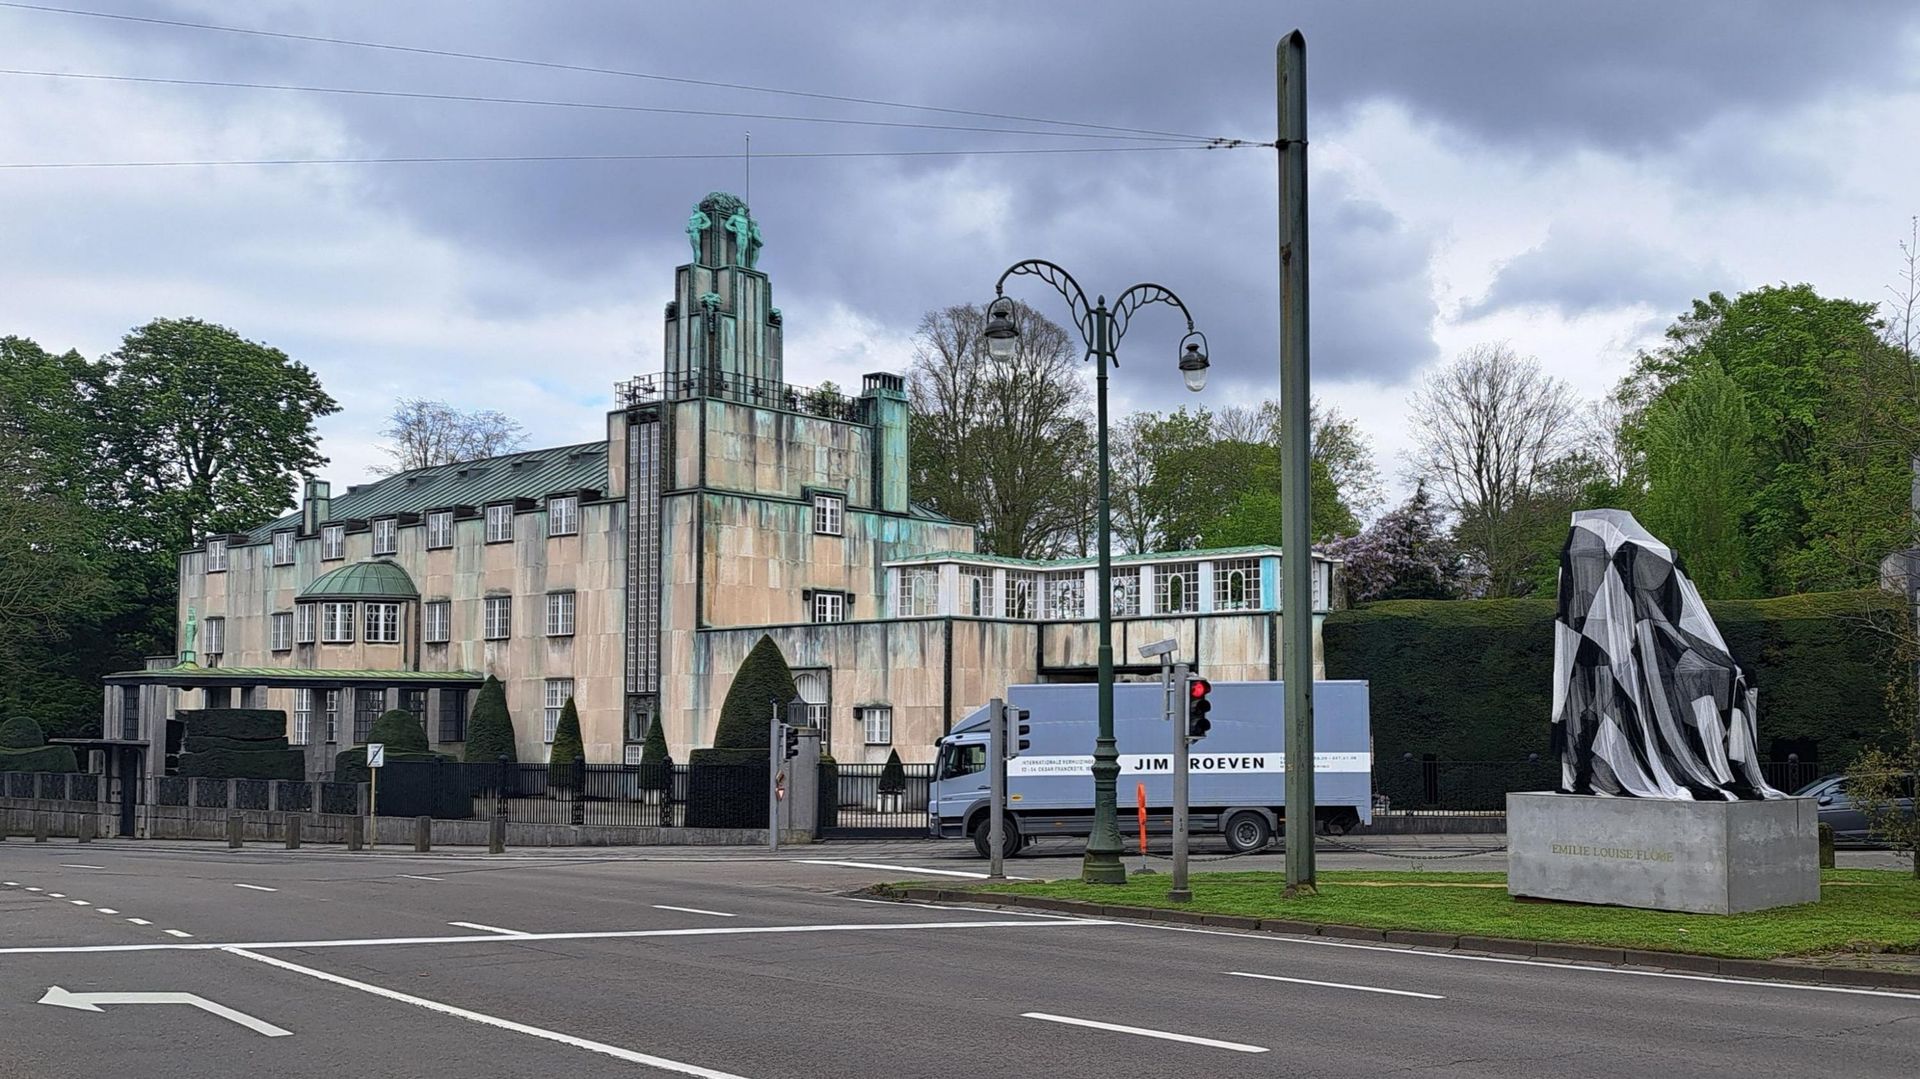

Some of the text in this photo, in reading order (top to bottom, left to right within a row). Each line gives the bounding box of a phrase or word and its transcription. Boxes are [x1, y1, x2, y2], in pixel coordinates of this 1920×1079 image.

[1134, 757, 1264, 770] JIM ROEVEN
[1552, 844, 1591, 857] EMILIE
[1593, 847, 1634, 859] LOUISE
